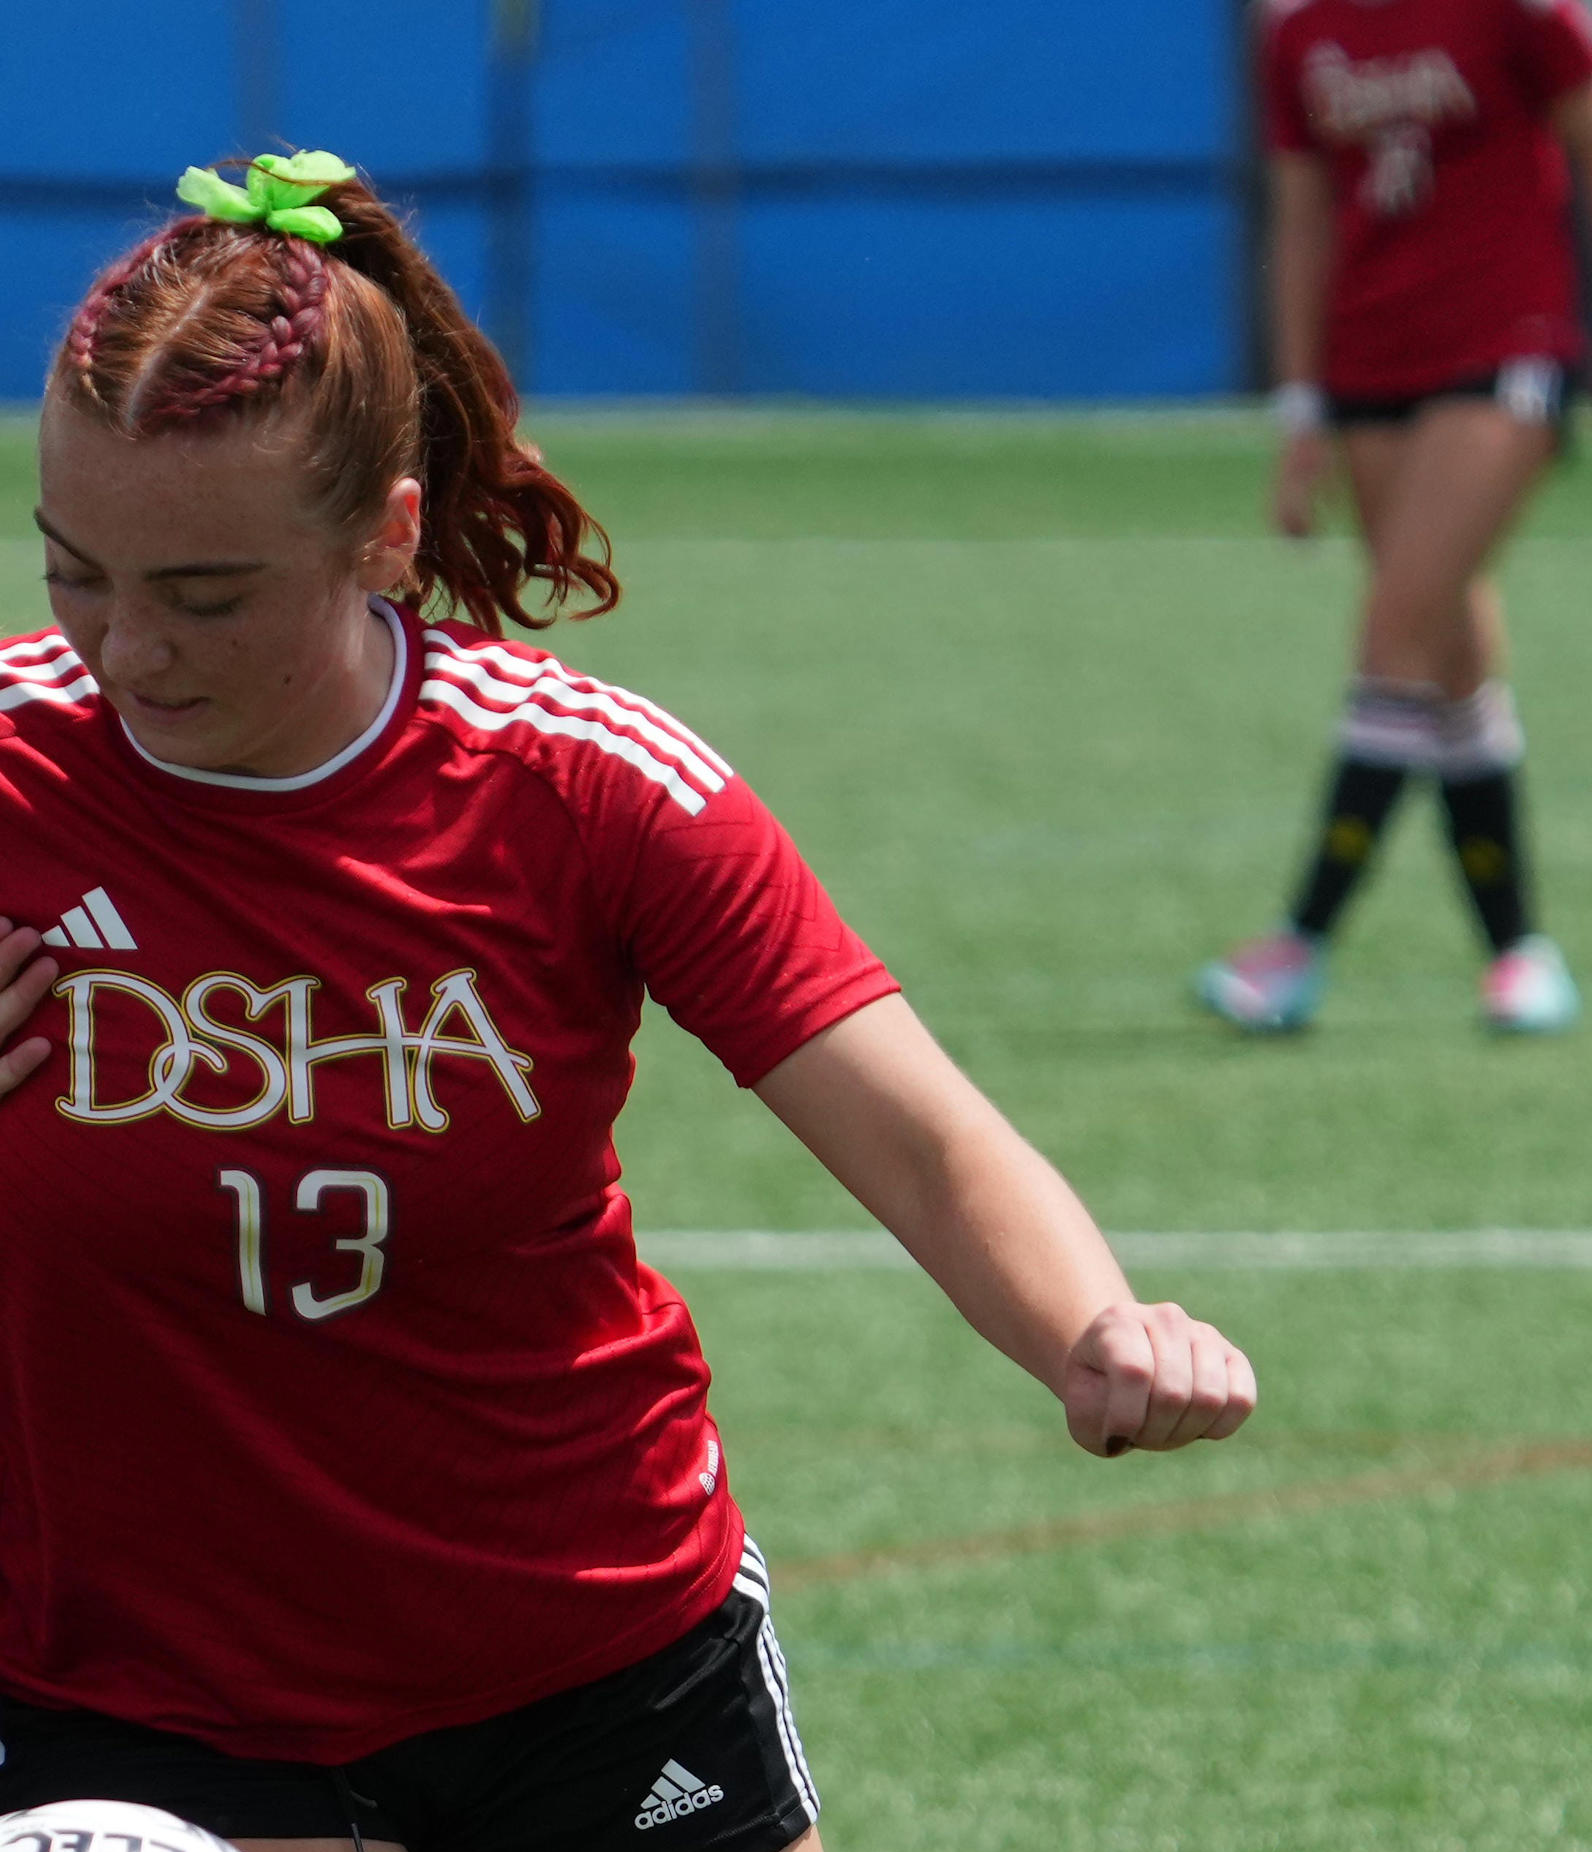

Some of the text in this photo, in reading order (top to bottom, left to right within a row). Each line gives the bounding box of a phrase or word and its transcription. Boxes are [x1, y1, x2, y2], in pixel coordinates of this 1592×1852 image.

[52, 968, 542, 1133] DSHA
[219, 1168, 389, 1320] 13
[634, 1784, 724, 1830] adidas
